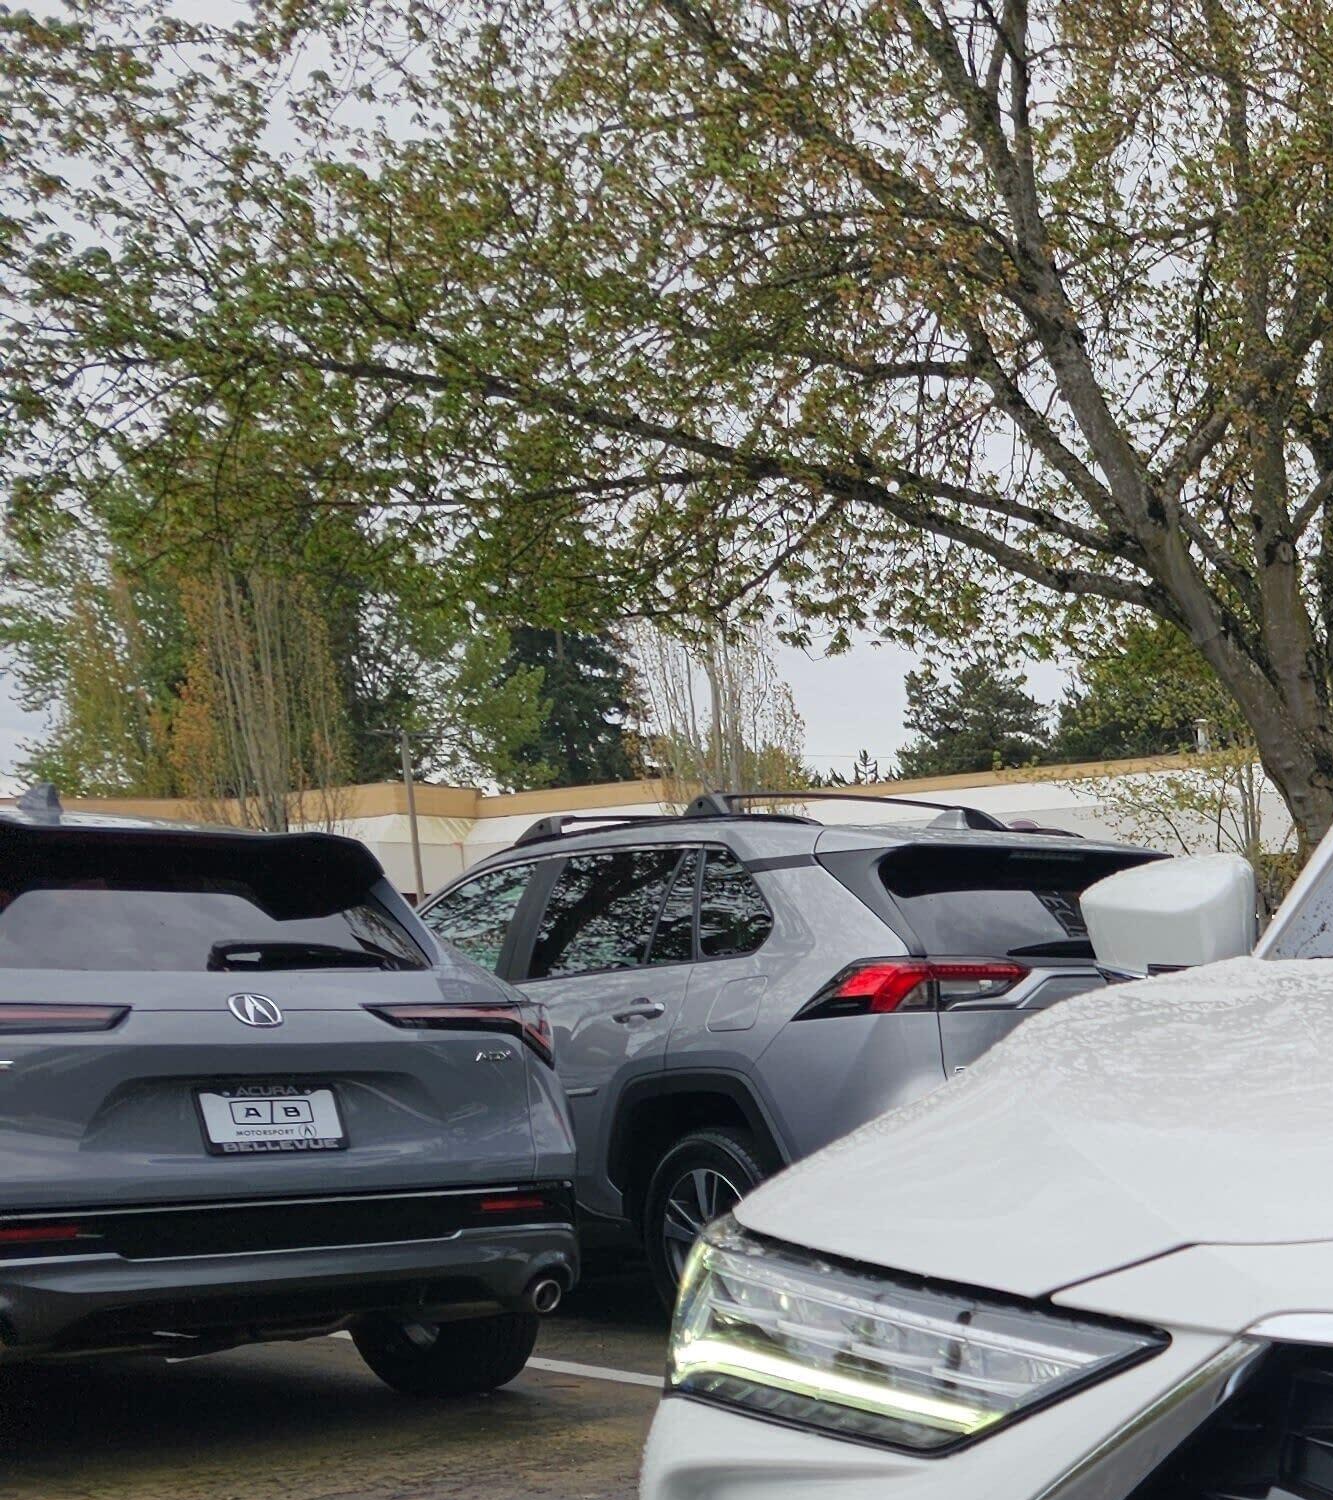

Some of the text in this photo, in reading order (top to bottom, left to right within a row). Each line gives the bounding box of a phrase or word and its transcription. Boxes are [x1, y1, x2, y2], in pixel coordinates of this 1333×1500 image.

[235, 1086, 299, 1097] ACURA
[236, 1128, 294, 1137] MOTORSPORT
[223, 1138, 340, 1153] BELLEVUE
